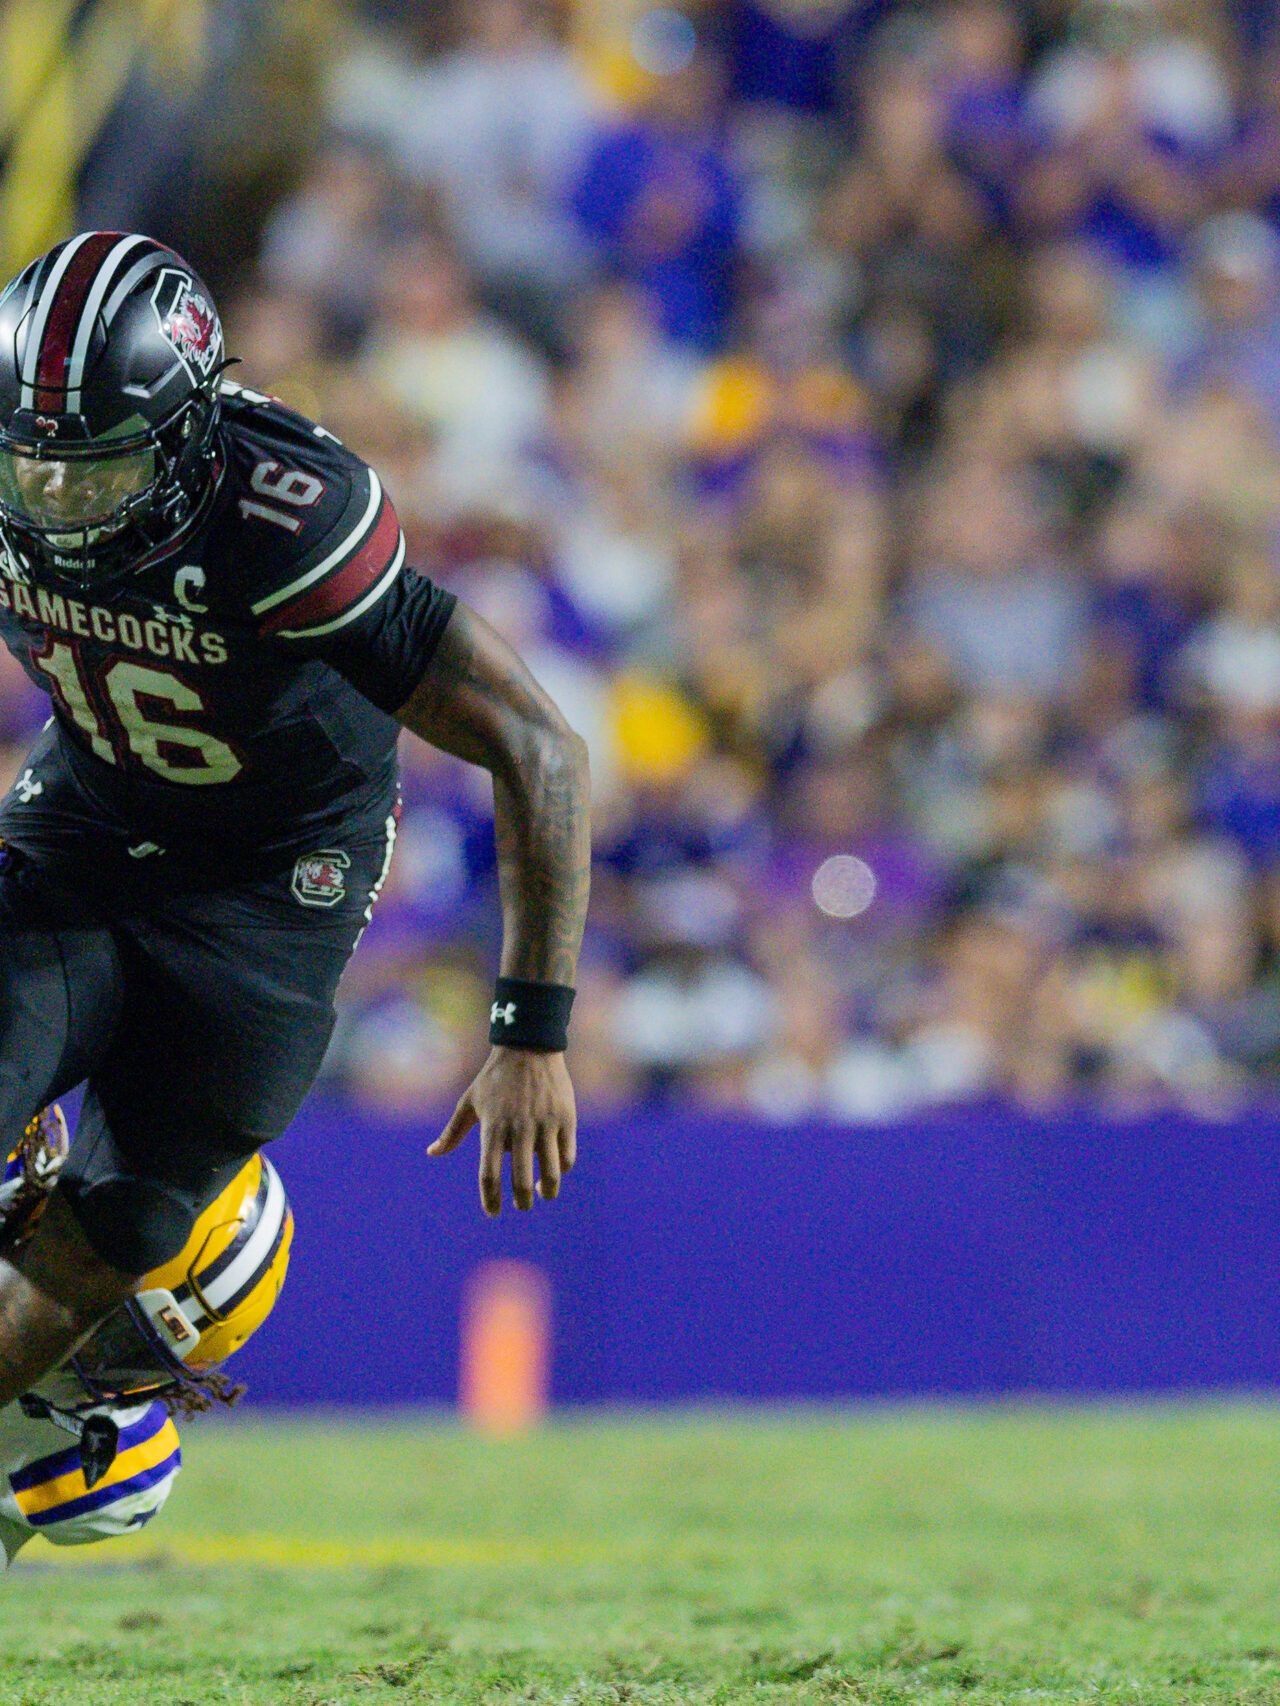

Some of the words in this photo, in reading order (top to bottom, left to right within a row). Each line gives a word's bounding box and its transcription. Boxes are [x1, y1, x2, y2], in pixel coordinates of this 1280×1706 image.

[237, 460, 327, 536] 16
[173, 565, 209, 614] C
[32, 636, 246, 787] 16
